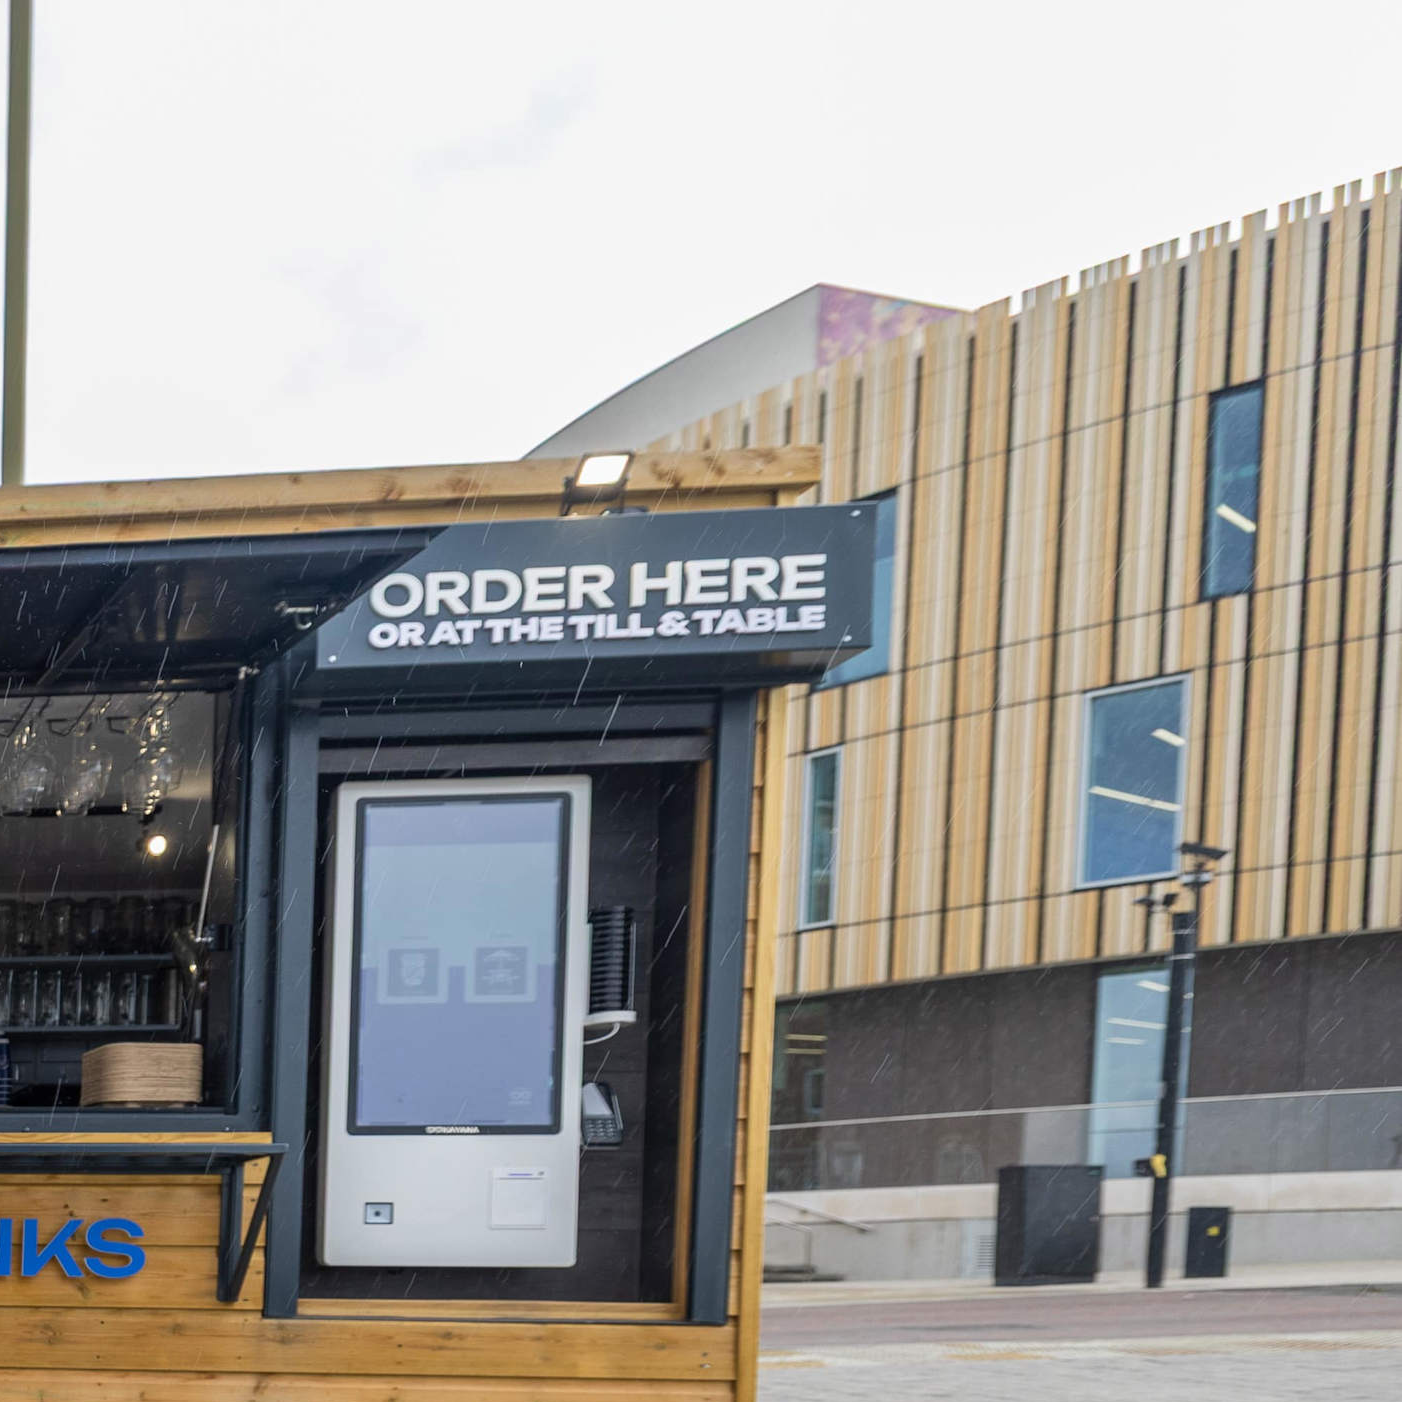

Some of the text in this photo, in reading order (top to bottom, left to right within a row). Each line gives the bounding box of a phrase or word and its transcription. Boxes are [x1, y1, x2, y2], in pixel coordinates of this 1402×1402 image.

[369, 553, 828, 619] ORDER HERE
[367, 621, 428, 650] OR
[427, 618, 482, 647] AT
[482, 615, 565, 644] THE
[566, 610, 655, 642] TILL
[691, 604, 828, 637] TABLE
